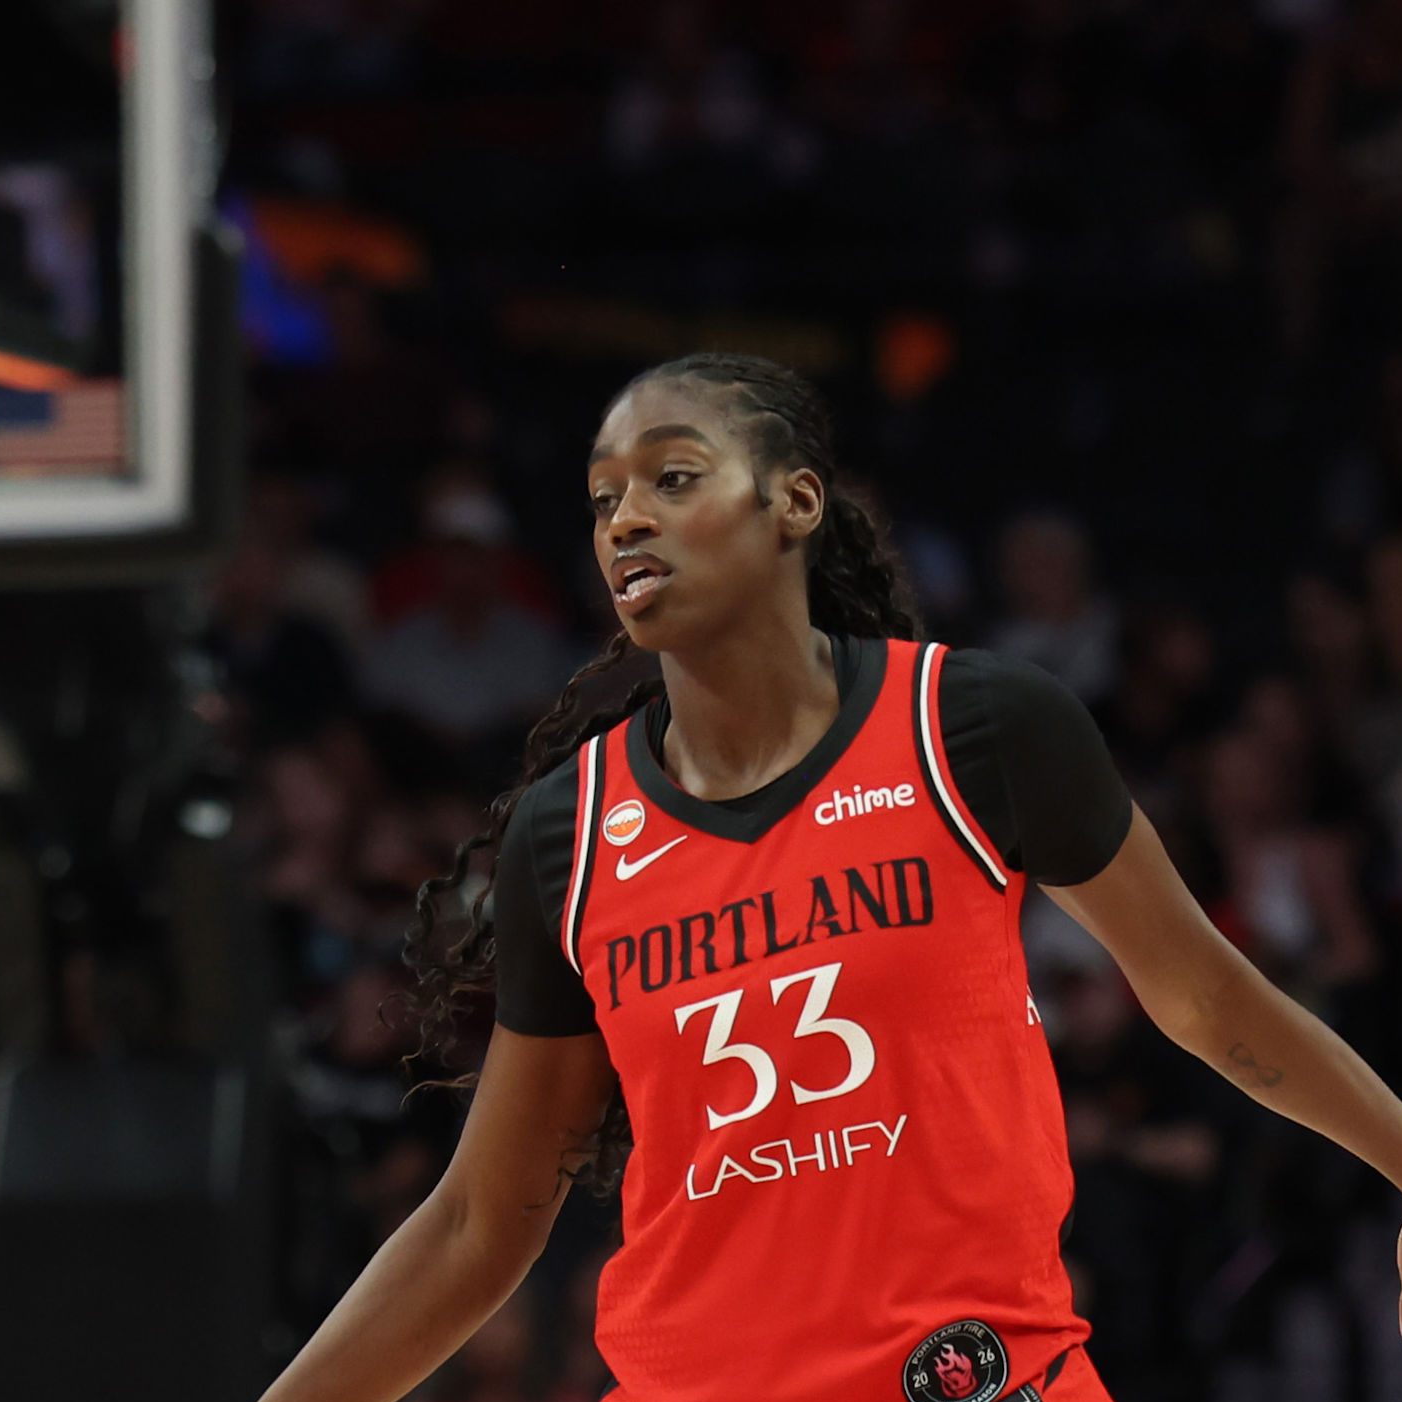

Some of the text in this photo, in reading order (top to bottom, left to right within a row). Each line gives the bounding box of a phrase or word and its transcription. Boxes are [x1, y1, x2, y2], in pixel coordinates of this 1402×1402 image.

[814, 783, 916, 825] chime
[606, 856, 934, 1011] PORTLAND
[674, 962, 876, 1131] 33
[686, 1114, 908, 1201] LASHIFY
[911, 1323, 986, 1365] PORTLAND FIRE
[912, 1347, 996, 1388] 20 26
